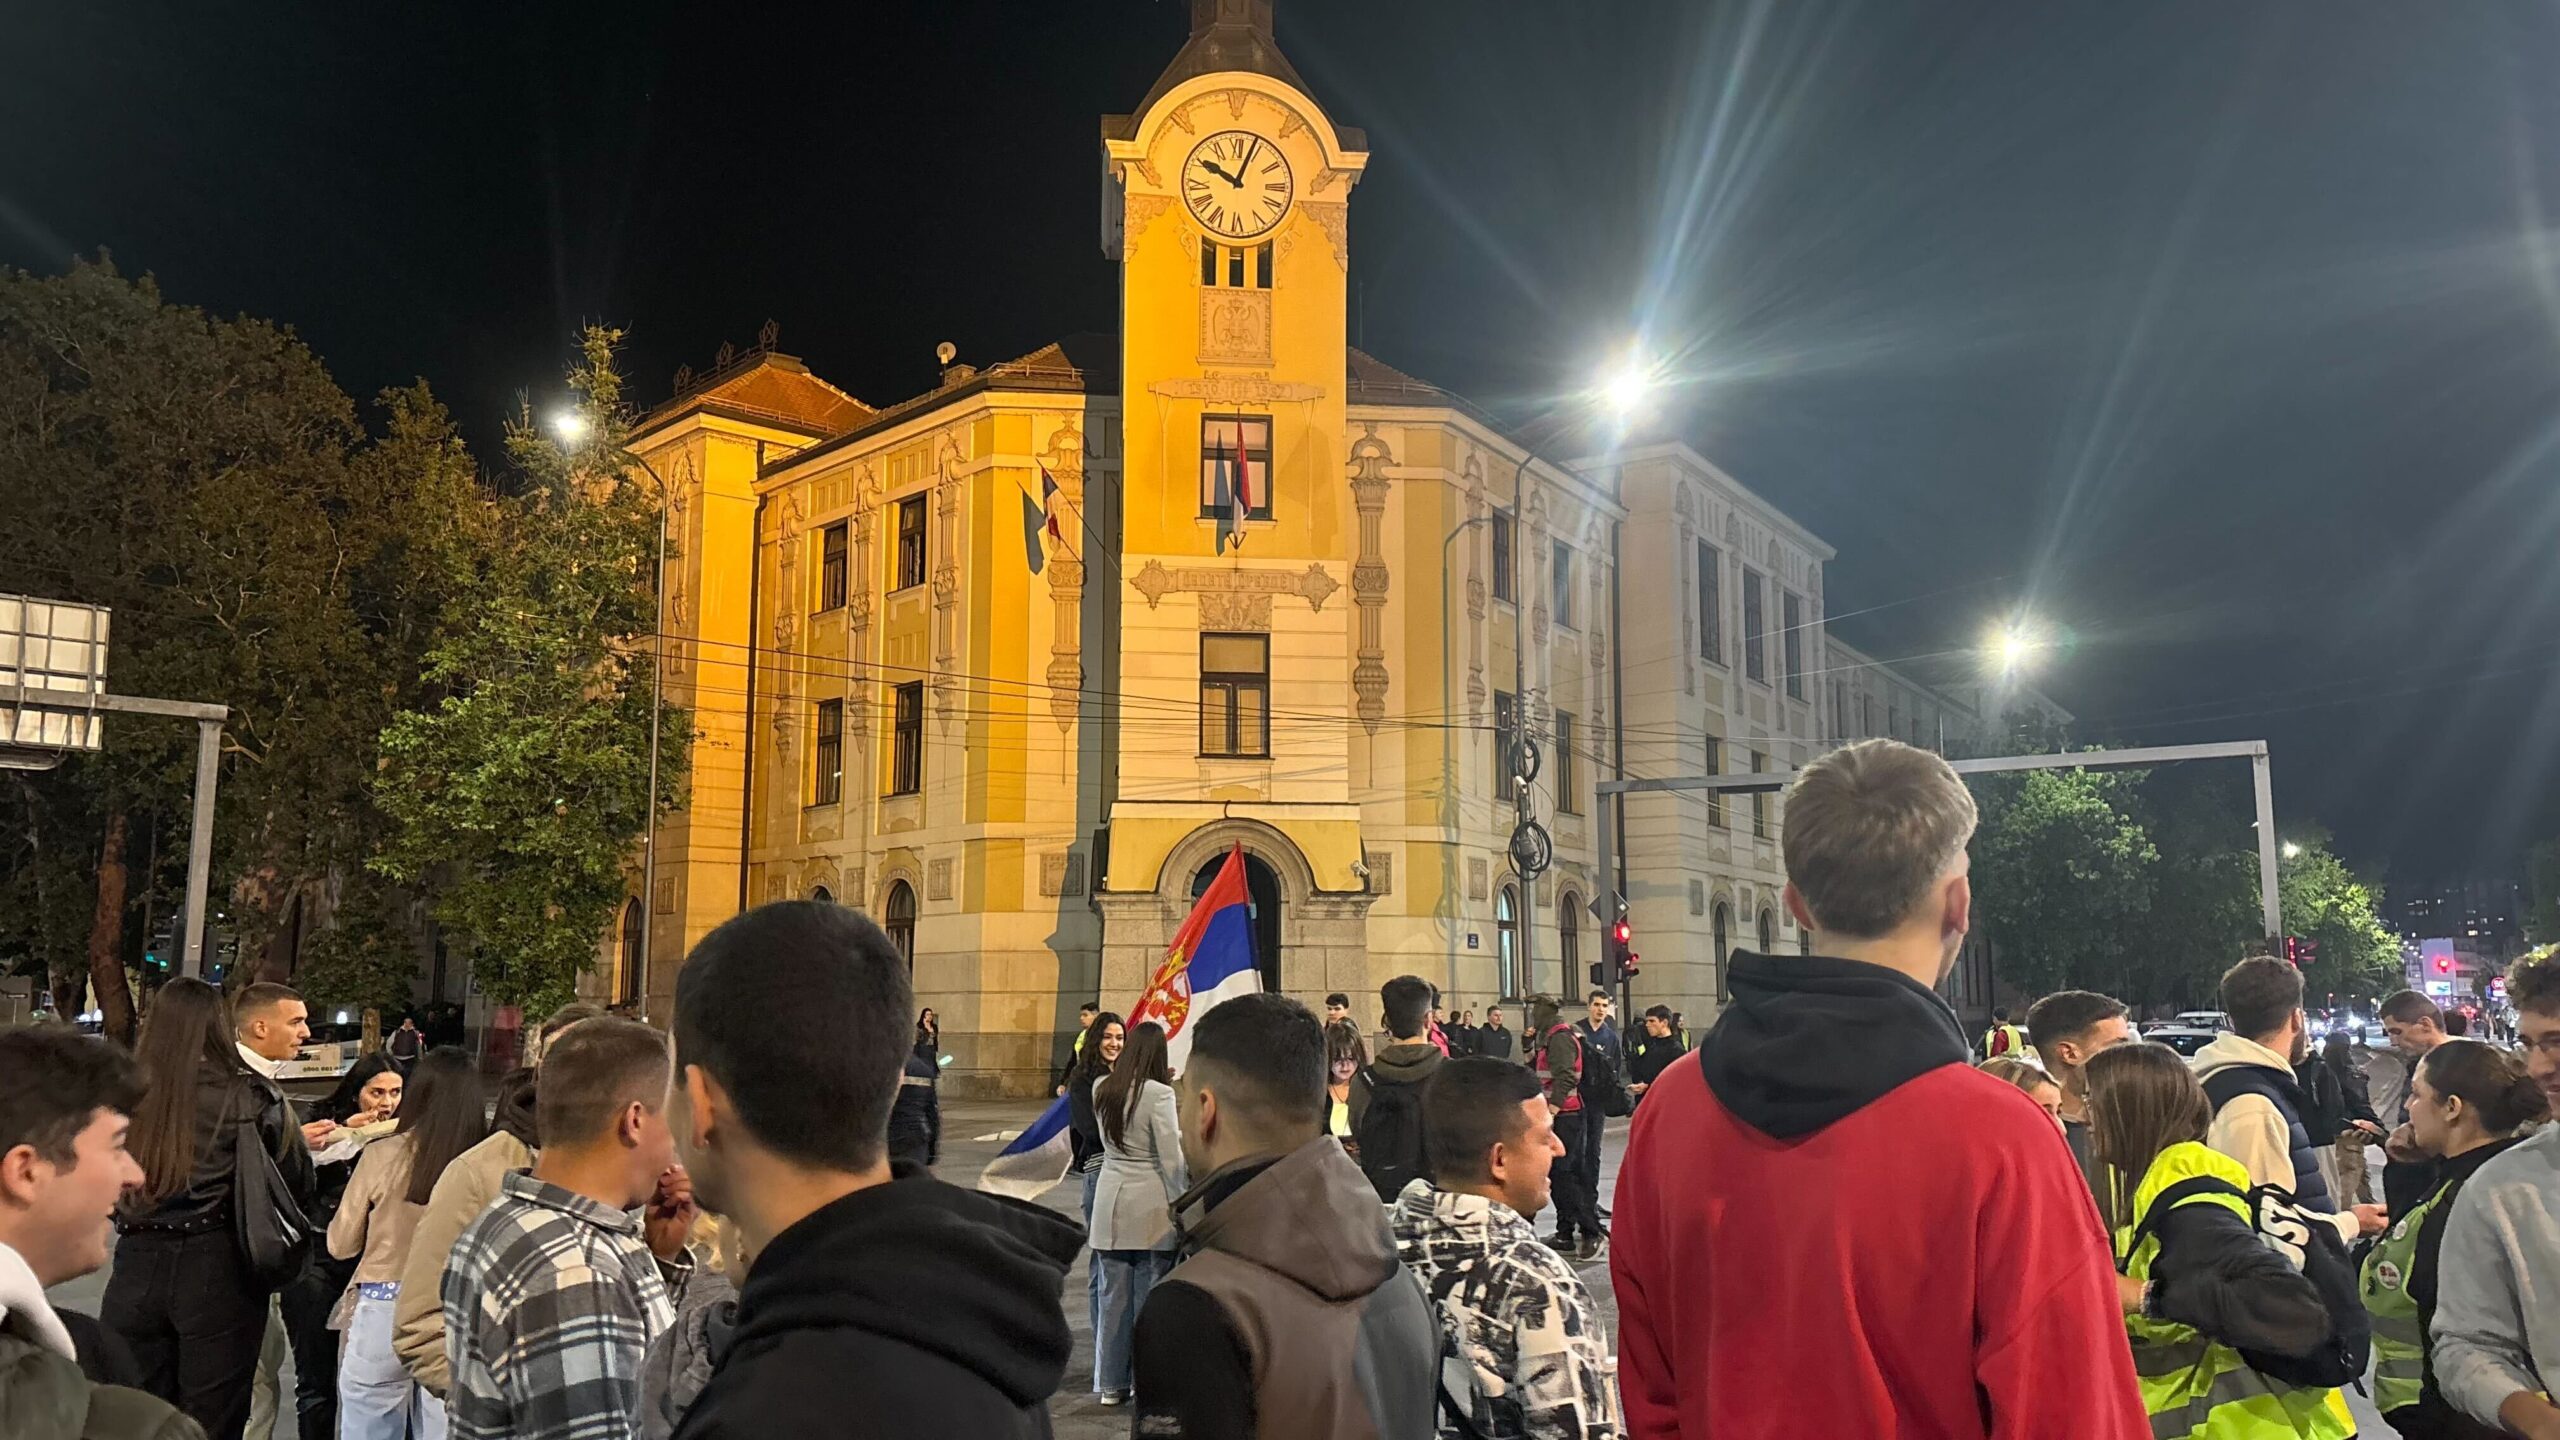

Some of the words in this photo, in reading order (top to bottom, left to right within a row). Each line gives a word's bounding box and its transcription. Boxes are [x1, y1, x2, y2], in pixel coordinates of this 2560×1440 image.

[1206, 141, 1227, 163] XI
[1228, 138, 1245, 160] XII
[1261, 161, 1280, 175] II
[1188, 177, 1211, 192] IX
[1264, 182, 1287, 193] III
[1207, 205, 1224, 228] VII
[1230, 210, 1244, 233] VI
[1252, 209, 1267, 229] V
